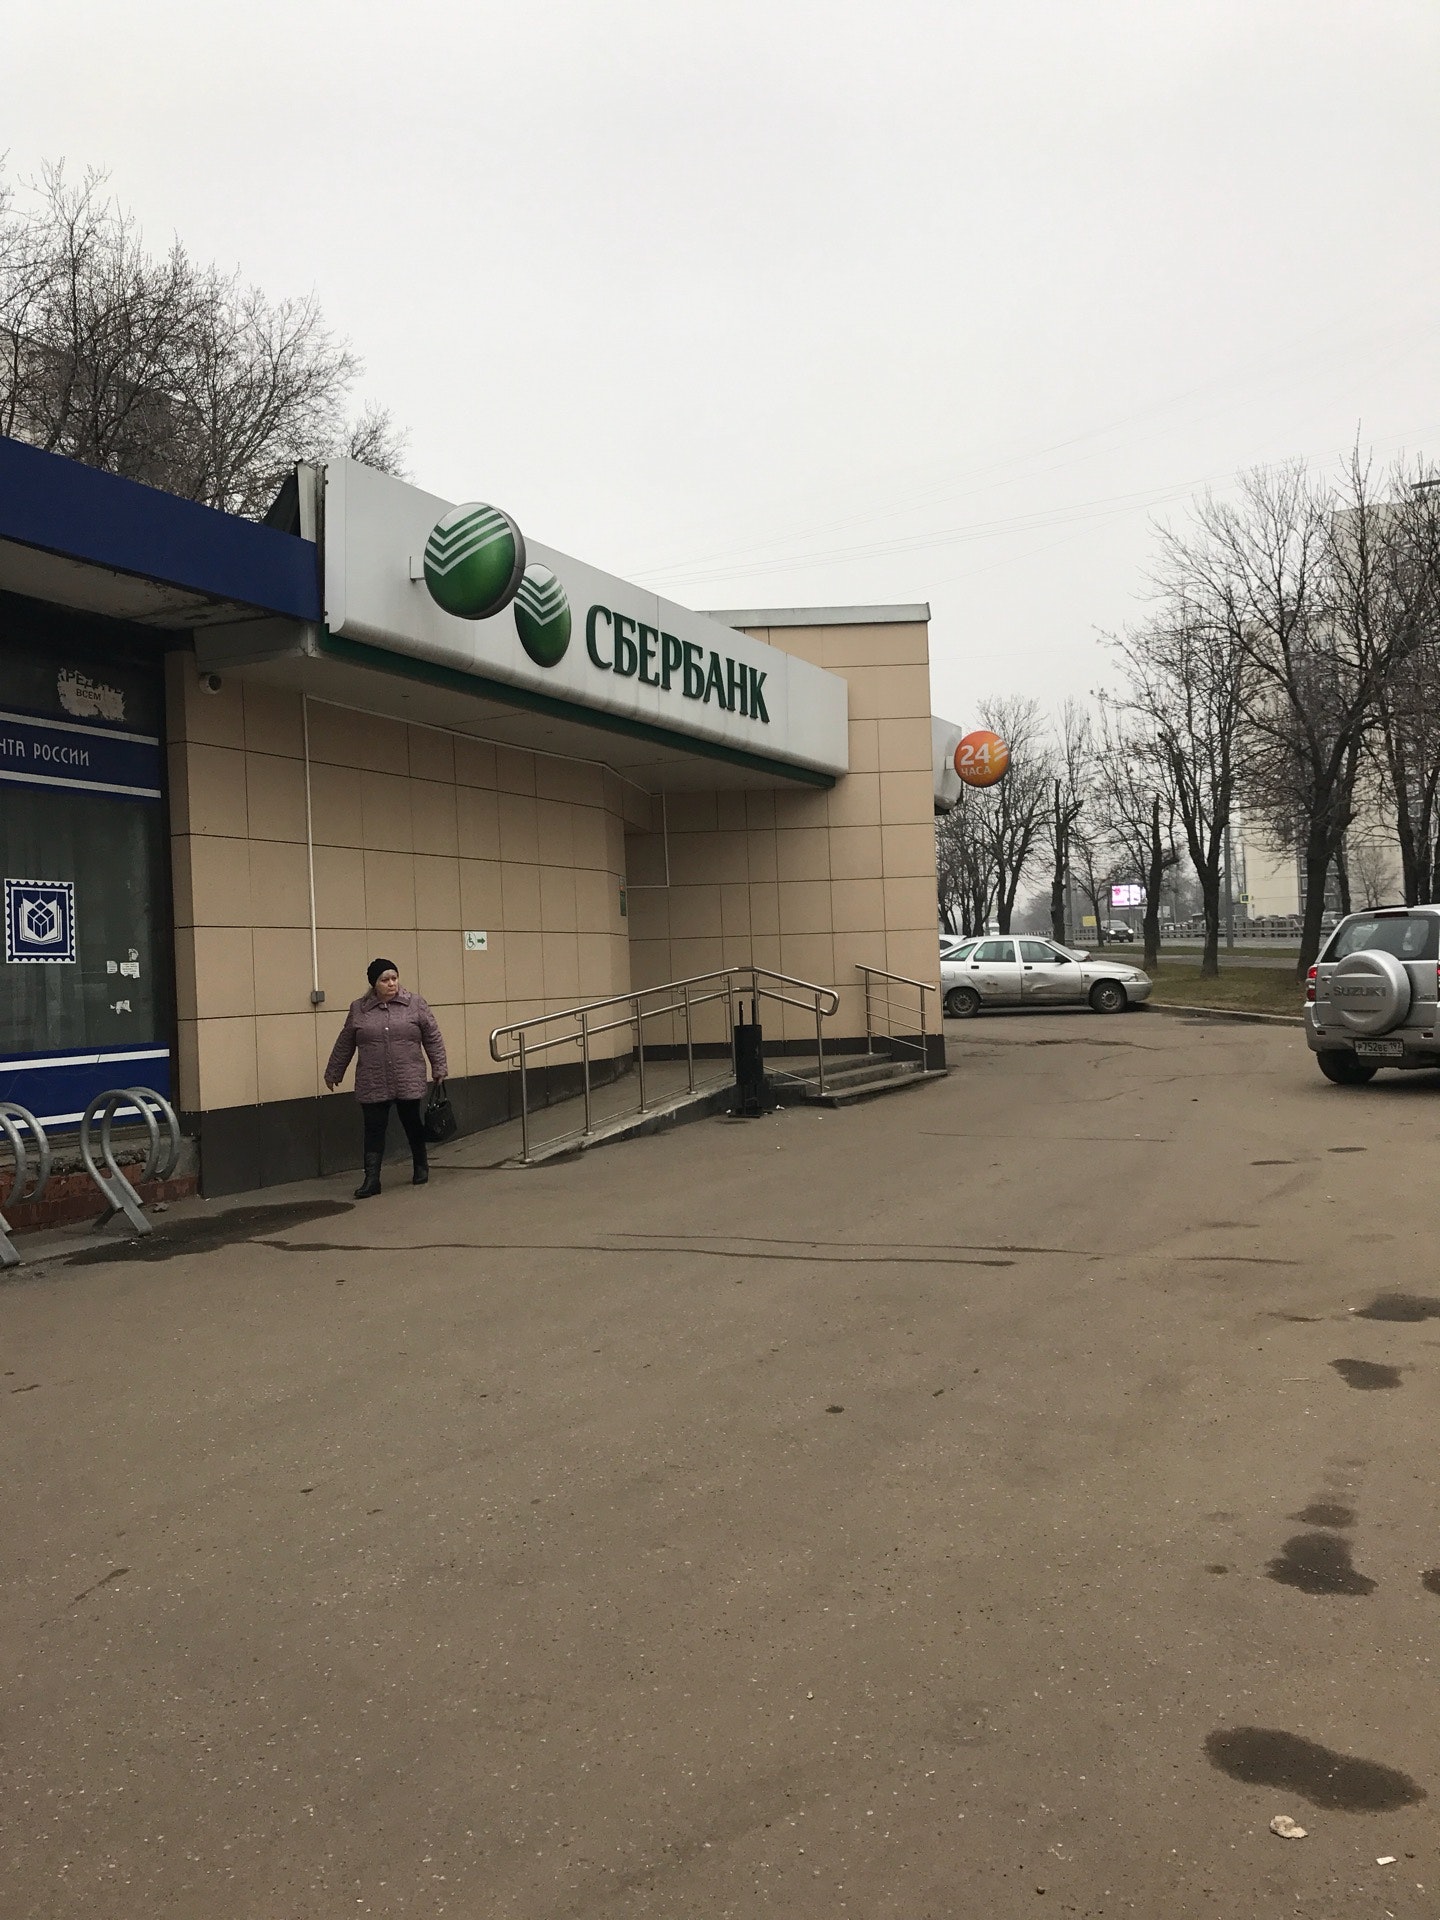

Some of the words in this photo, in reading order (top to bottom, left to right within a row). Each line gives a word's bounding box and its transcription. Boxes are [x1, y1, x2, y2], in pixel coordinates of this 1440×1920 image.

[586, 604, 770, 723] СБЕРБАНК
[76, 688, 102, 701] ВСЕМ
[33, 742, 90, 767] РОССИИ
[960, 742, 991, 766] 24
[961, 765, 992, 776] ЧАСА
[1333, 986, 1387, 997] SUZUKI
